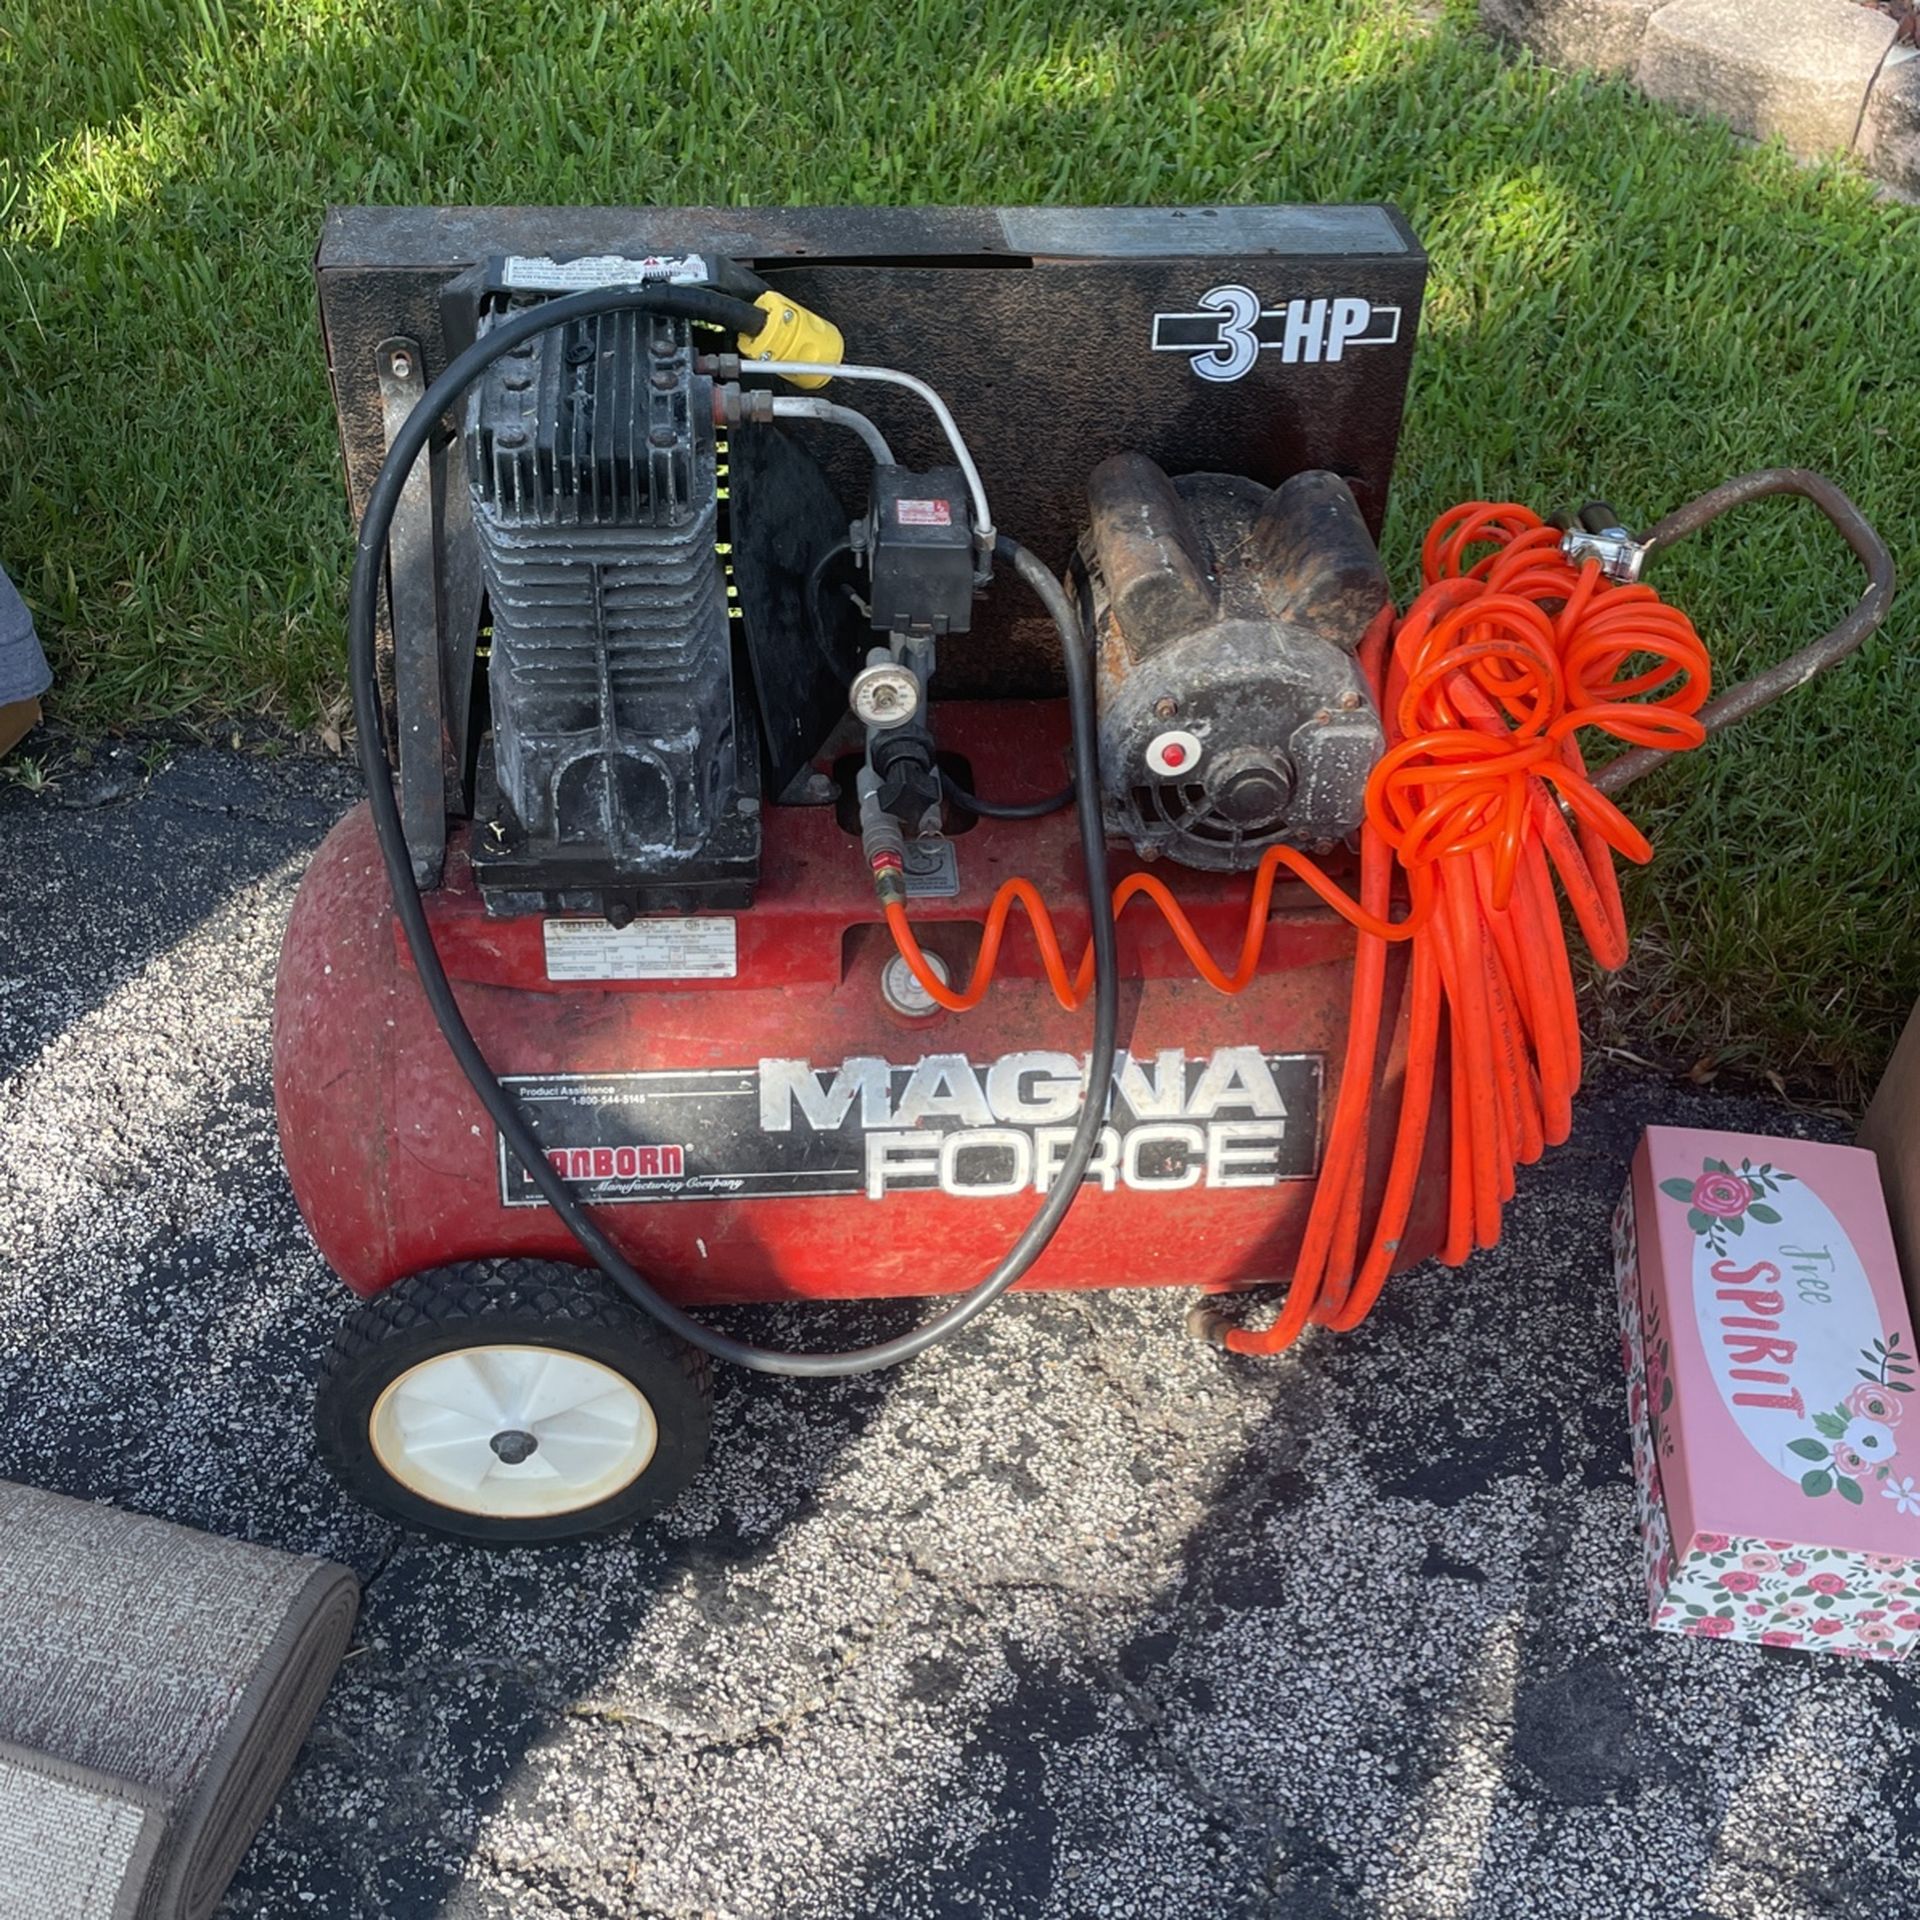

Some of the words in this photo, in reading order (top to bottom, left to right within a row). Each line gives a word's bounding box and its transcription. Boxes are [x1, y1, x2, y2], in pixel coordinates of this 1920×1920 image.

[1190, 284, 1260, 382] 3
[1281, 298, 1370, 363] HP
[520, 1087, 558, 1097] Product
[561, 1085, 615, 1096] Assistance
[759, 1046, 1287, 1131] MAGNA
[523, 1145, 684, 1182] ANBORN
[590, 1180, 683, 1194] Manufacturing
[686, 1177, 744, 1192] Company
[865, 1121, 1287, 1199] FORCE
[1710, 1260, 1805, 1419] SPIRIT
